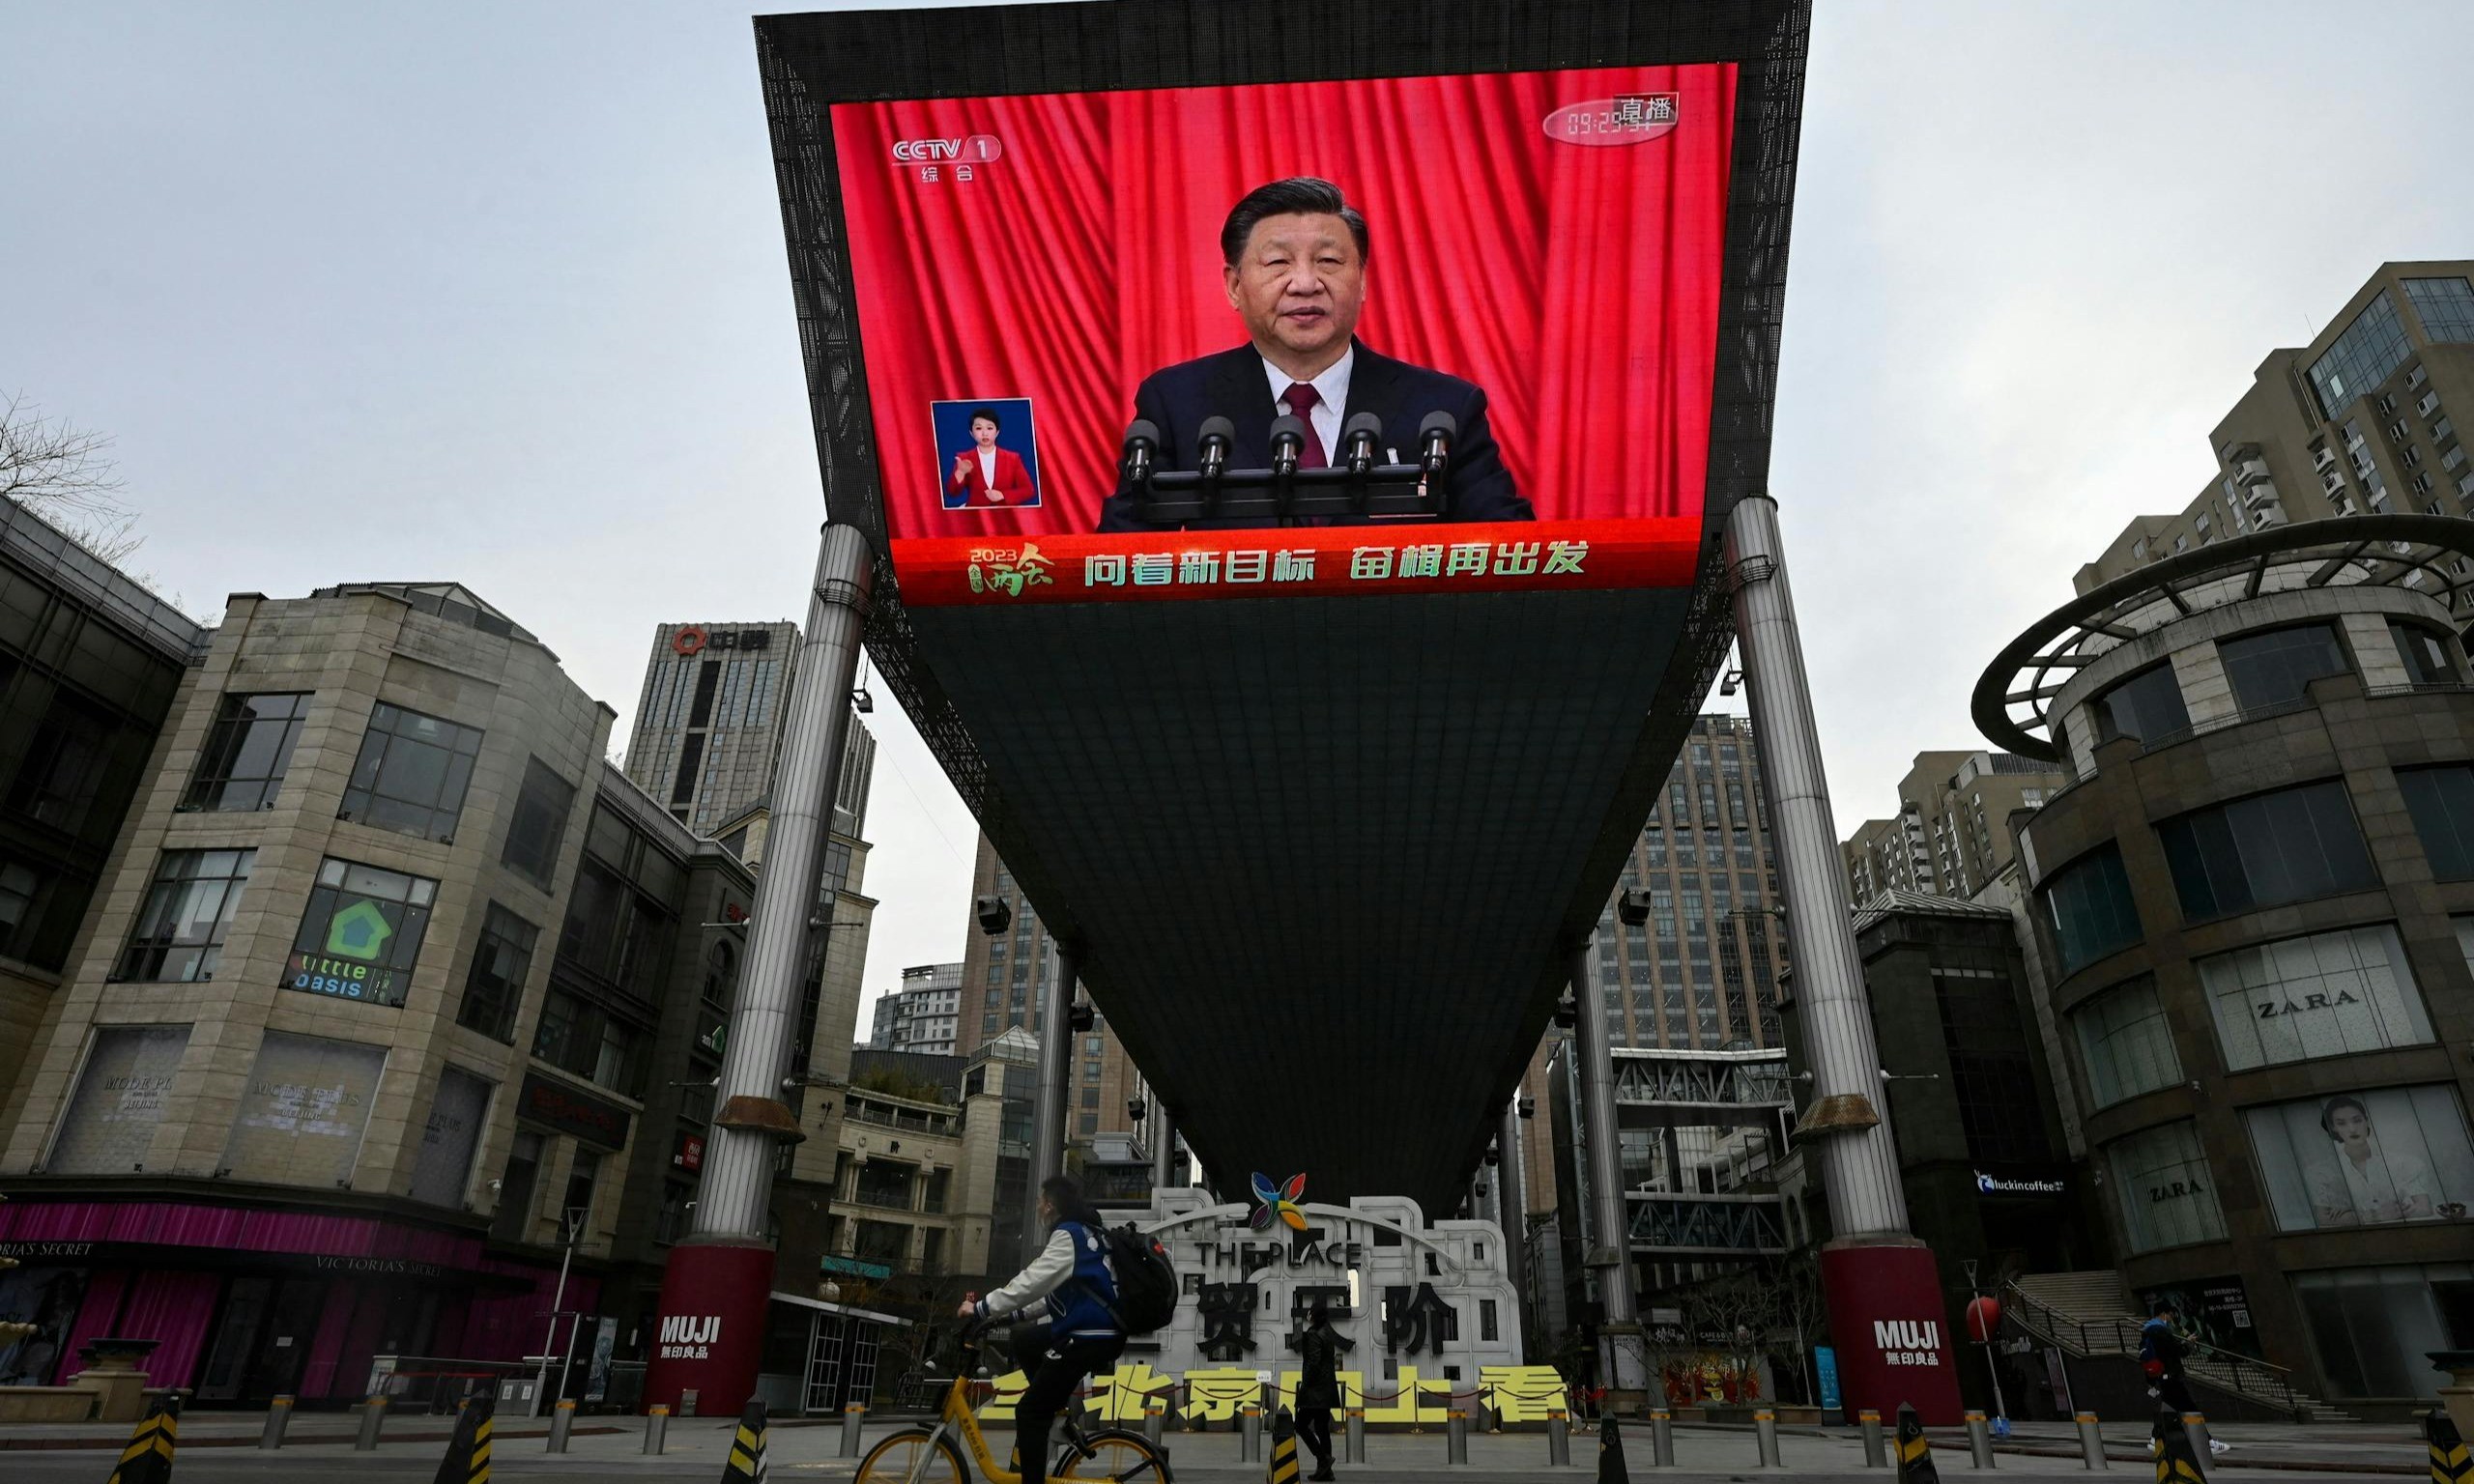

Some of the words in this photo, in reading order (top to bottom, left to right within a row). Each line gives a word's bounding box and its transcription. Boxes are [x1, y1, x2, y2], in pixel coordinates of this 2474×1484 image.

[1621, 98, 1671, 120] 直播
[892, 138, 962, 160] CCTV
[977, 140, 987, 158] 1
[969, 549, 1018, 562] 2023
[1084, 549, 1316, 586] 向着新目标
[1350, 540, 1589, 579] 奋楫再出发
[294, 974, 362, 997] oasis
[2258, 989, 2359, 1018] ZARA
[103, 1076, 151, 1090] MODE
[253, 1081, 309, 1100] MODE
[2150, 1180, 2204, 1203] ZARA
[0, 1242, 37, 1256] RIA'S
[39, 1242, 94, 1256] SECRET
[1194, 1241, 1256, 1267] THE
[1269, 1241, 1362, 1267] PLACE
[316, 1256, 406, 1272] VICTORIA'S
[410, 1262, 442, 1278] SECRET
[1126, 1281, 1456, 1355] 贸天阶
[659, 1316, 721, 1343] MUJI
[1874, 1320, 1941, 1350] MUJI
[660, 1345, 708, 1359] 無印良品
[1885, 1352, 1939, 1366] 無印良品
